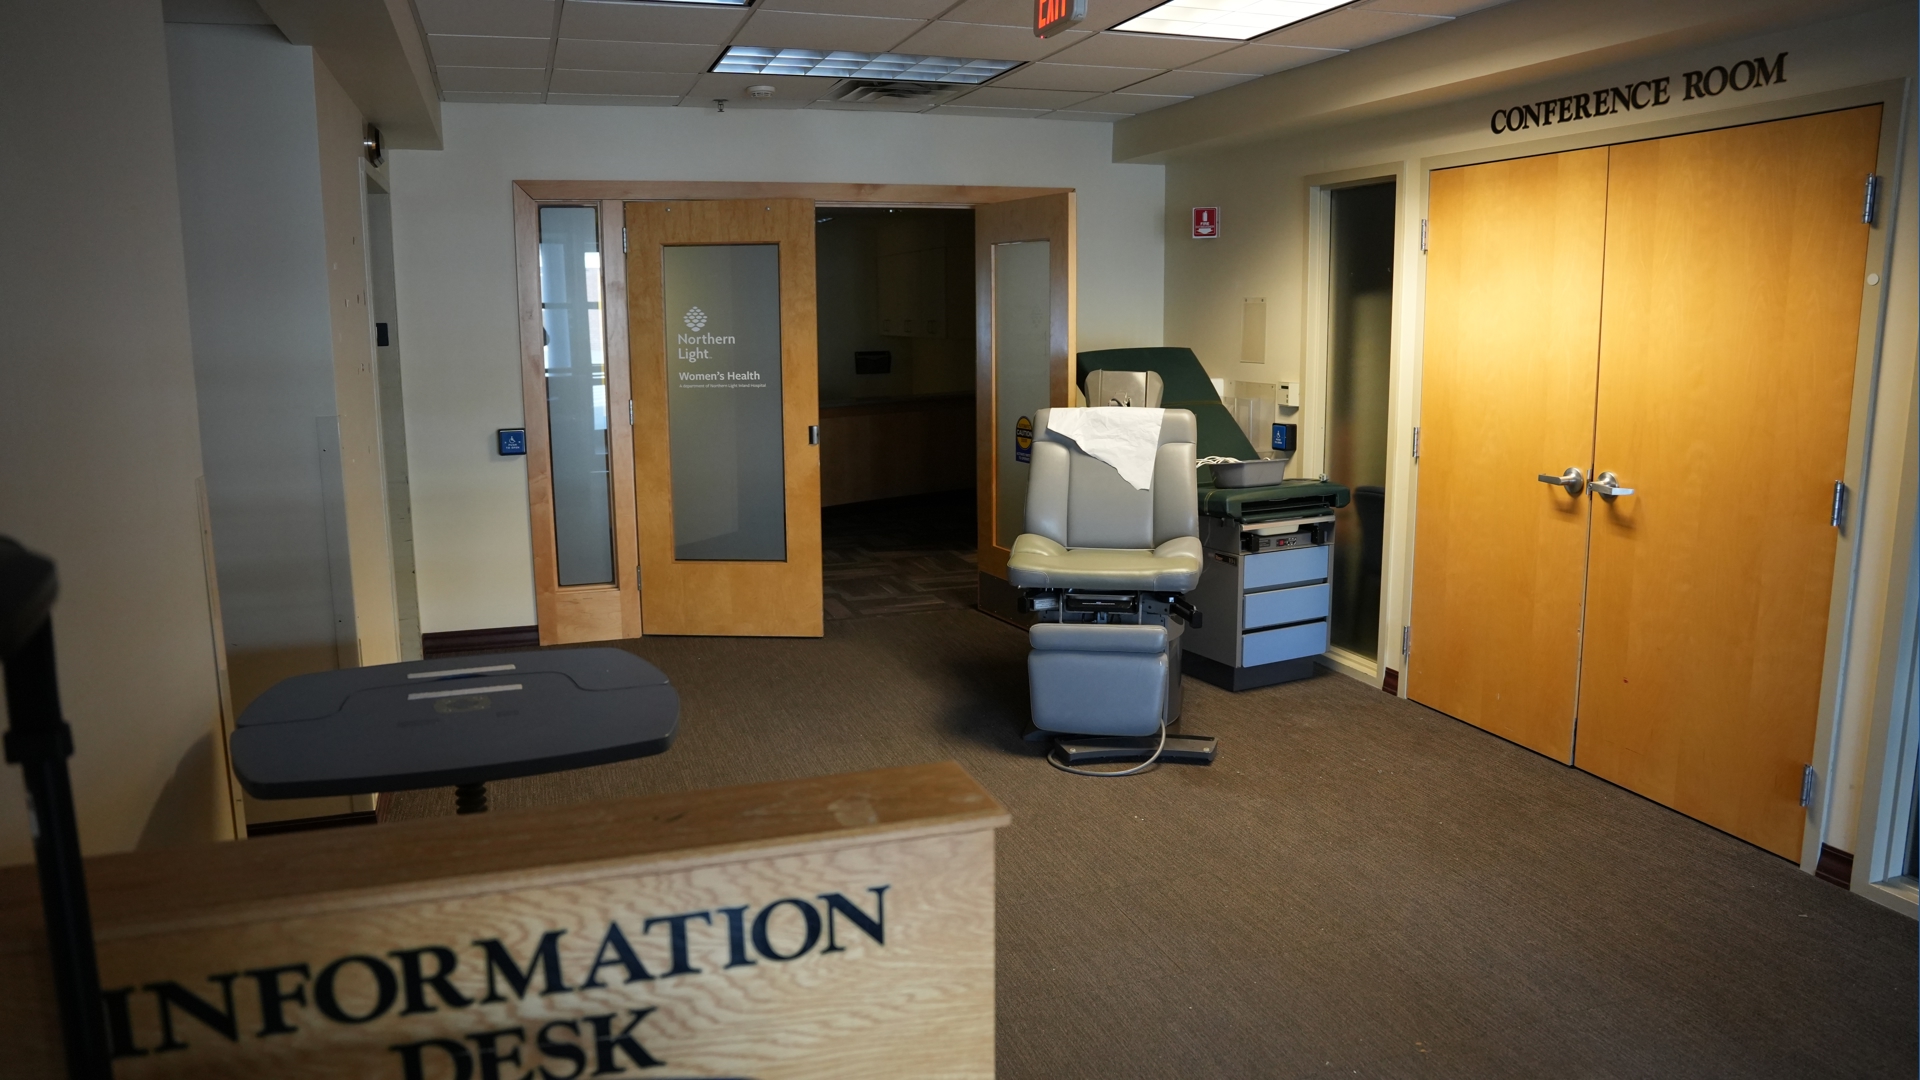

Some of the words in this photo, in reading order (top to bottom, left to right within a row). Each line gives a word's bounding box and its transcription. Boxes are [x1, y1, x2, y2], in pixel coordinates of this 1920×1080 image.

[1490, 76, 1671, 135] CONFERENCE
[1682, 51, 1789, 101] ROOM
[678, 332, 736, 345] Northern
[678, 346, 709, 363] Light
[678, 371, 725, 381] Women’s
[727, 370, 761, 380] Health
[1016, 429, 1032, 438] CAUTION
[101, 885, 890, 1059] INFORMATION
[389, 1006, 667, 1080] DESK
